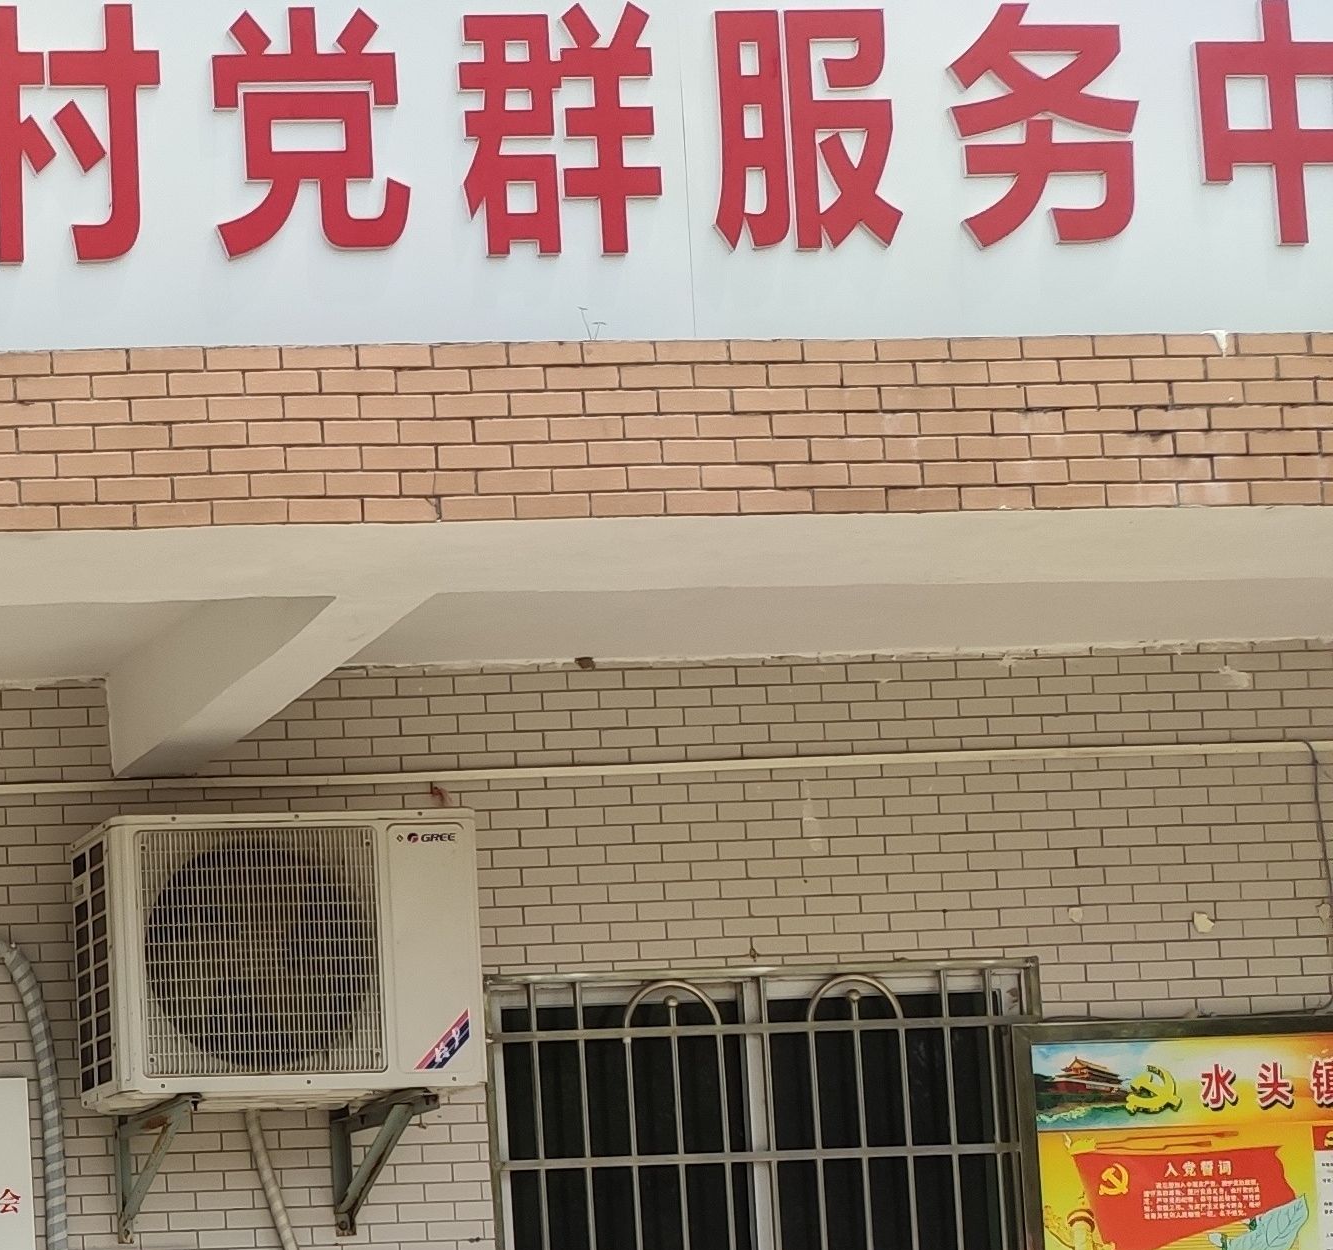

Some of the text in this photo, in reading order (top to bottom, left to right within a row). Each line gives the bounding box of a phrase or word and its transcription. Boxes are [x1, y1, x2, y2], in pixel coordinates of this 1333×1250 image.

[420, 831, 457, 843] GREE
[1164, 1159, 1233, 1178] 入党誓词
